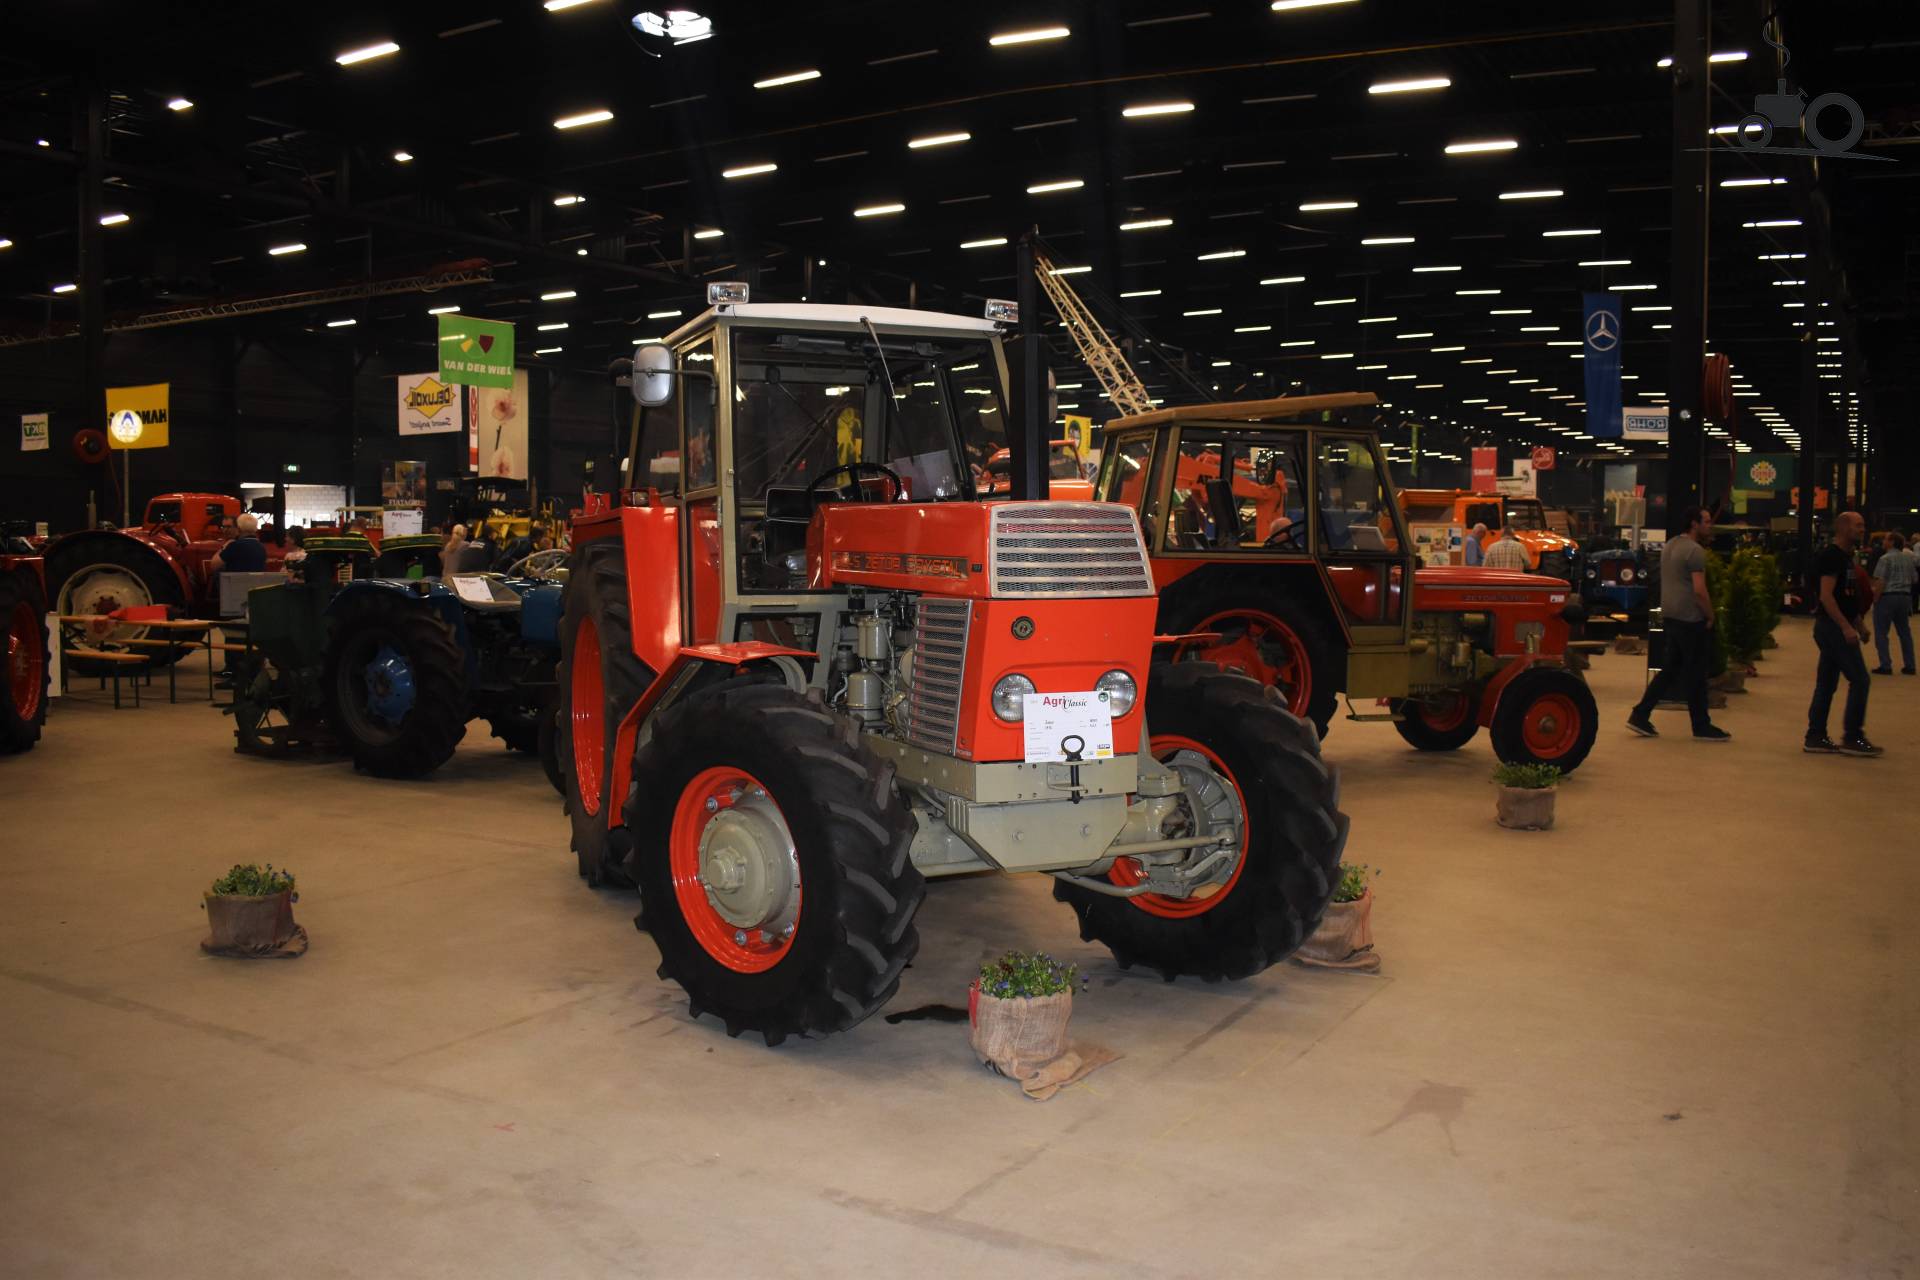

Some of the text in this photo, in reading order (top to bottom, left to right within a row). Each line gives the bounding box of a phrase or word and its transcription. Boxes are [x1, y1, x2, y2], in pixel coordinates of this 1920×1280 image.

[444, 359, 512, 375] VAN DER WIEL
[905, 557, 963, 579] CRYSTAL
[1043, 696, 1088, 710] Agri Classic
